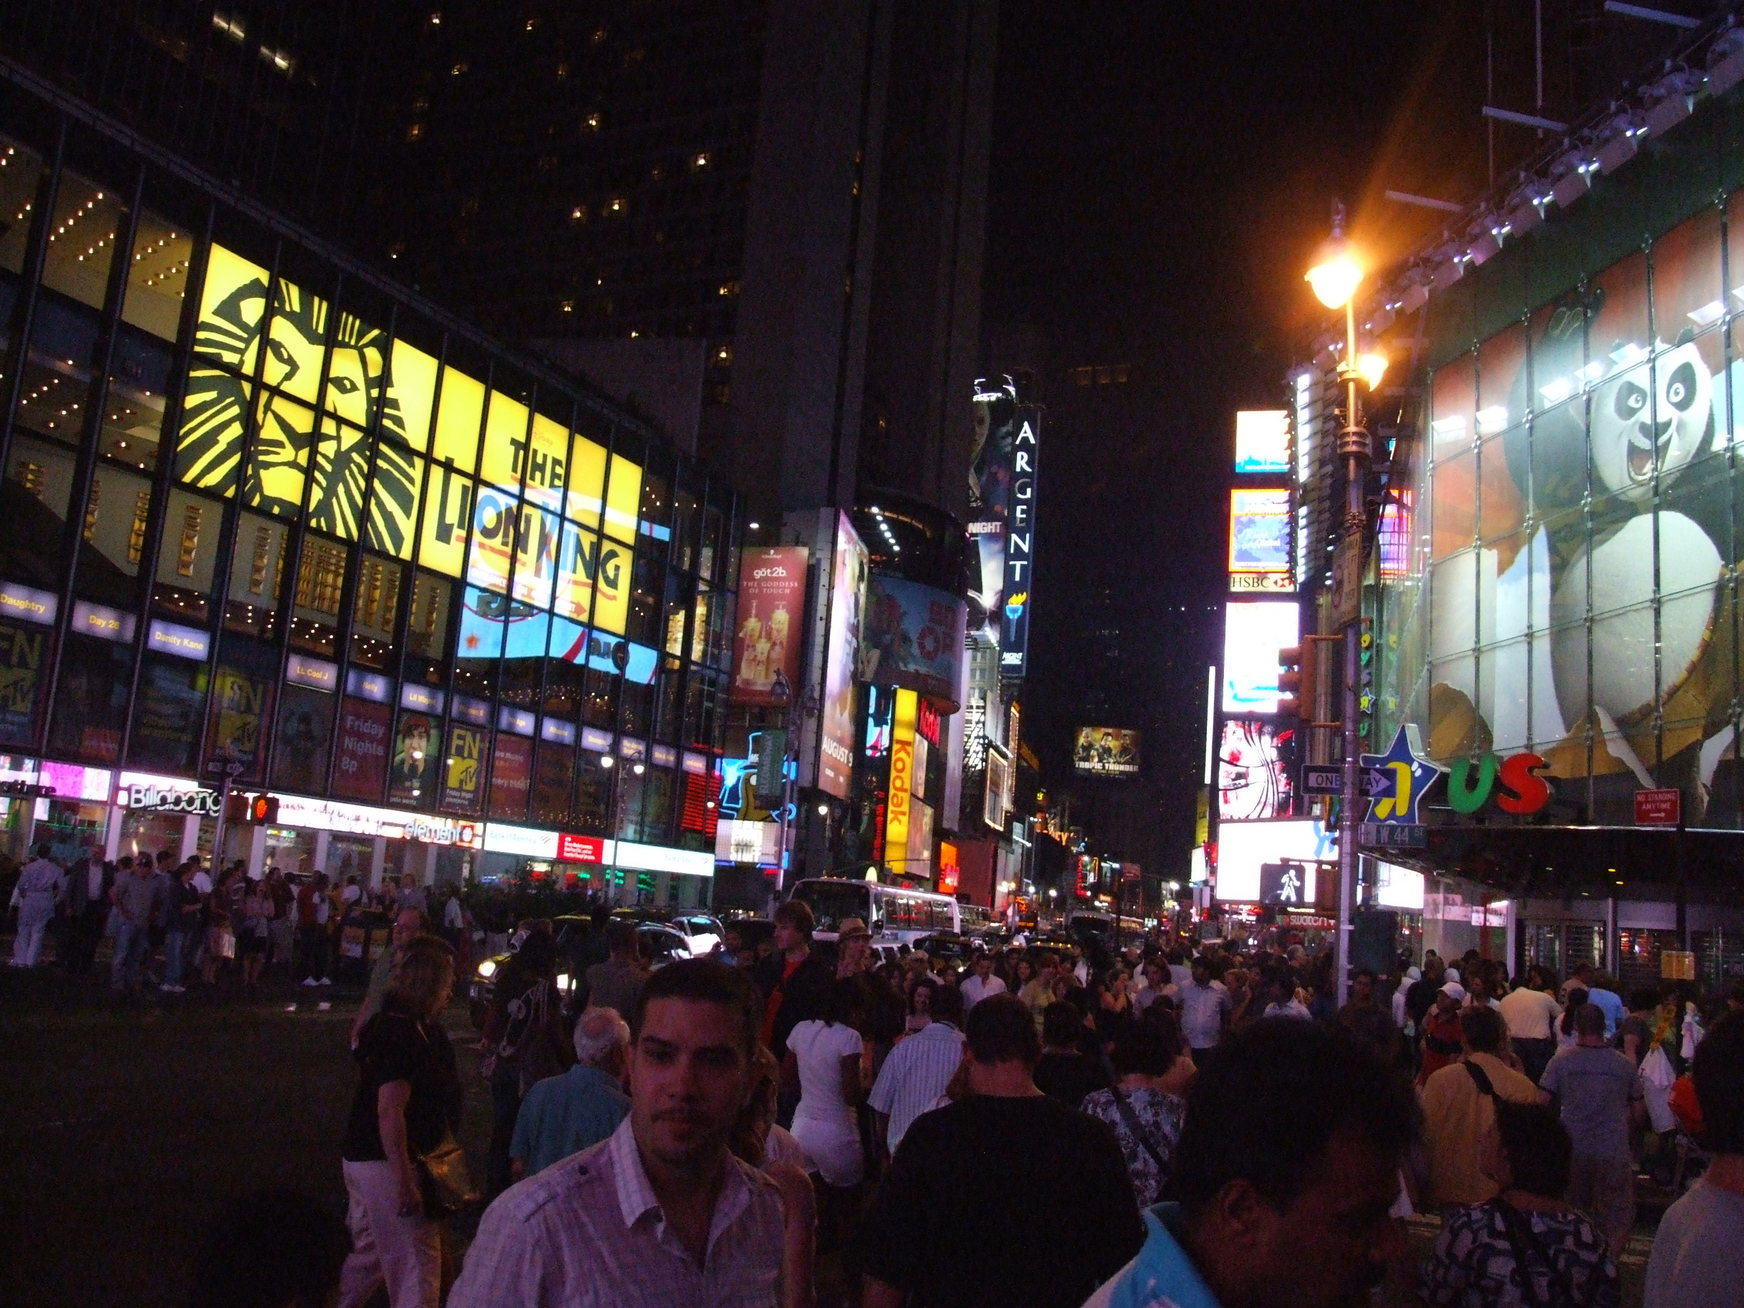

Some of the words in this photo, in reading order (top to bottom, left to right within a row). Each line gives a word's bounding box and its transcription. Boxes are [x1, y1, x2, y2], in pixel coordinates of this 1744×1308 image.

[509, 437, 564, 488] THE
[1009, 420, 1036, 582] ARGENT
[435, 455, 533, 555] LION
[533, 500, 621, 591] KING
[1232, 575, 1271, 588] HSBC
[1, 594, 45, 614] Daughtry
[89, 614, 107, 628] Day
[155, 631, 181, 646] Danity
[183, 638, 204, 650] Kane
[306, 668, 322, 679] Cool
[323, 671, 329, 680] J
[345, 715, 386, 740] Friday
[343, 736, 385, 757] Nights
[450, 728, 480, 760] FN
[821, 735, 849, 764] AUGUST
[848, 752, 854, 767] 9
[341, 756, 358, 774] 8p
[1075, 761, 1103, 769] TROPIC
[1104, 763, 1139, 772] THUNDER
[889, 738, 912, 826] Kodak
[1315, 774, 1340, 786] ONE
[1447, 753, 1550, 815] US
[129, 784, 222, 817] Billabong
[404, 822, 461, 844] element
[1380, 826, 1390, 844] W
[1393, 826, 1409, 845] 44
[1414, 827, 1424, 836] ST
